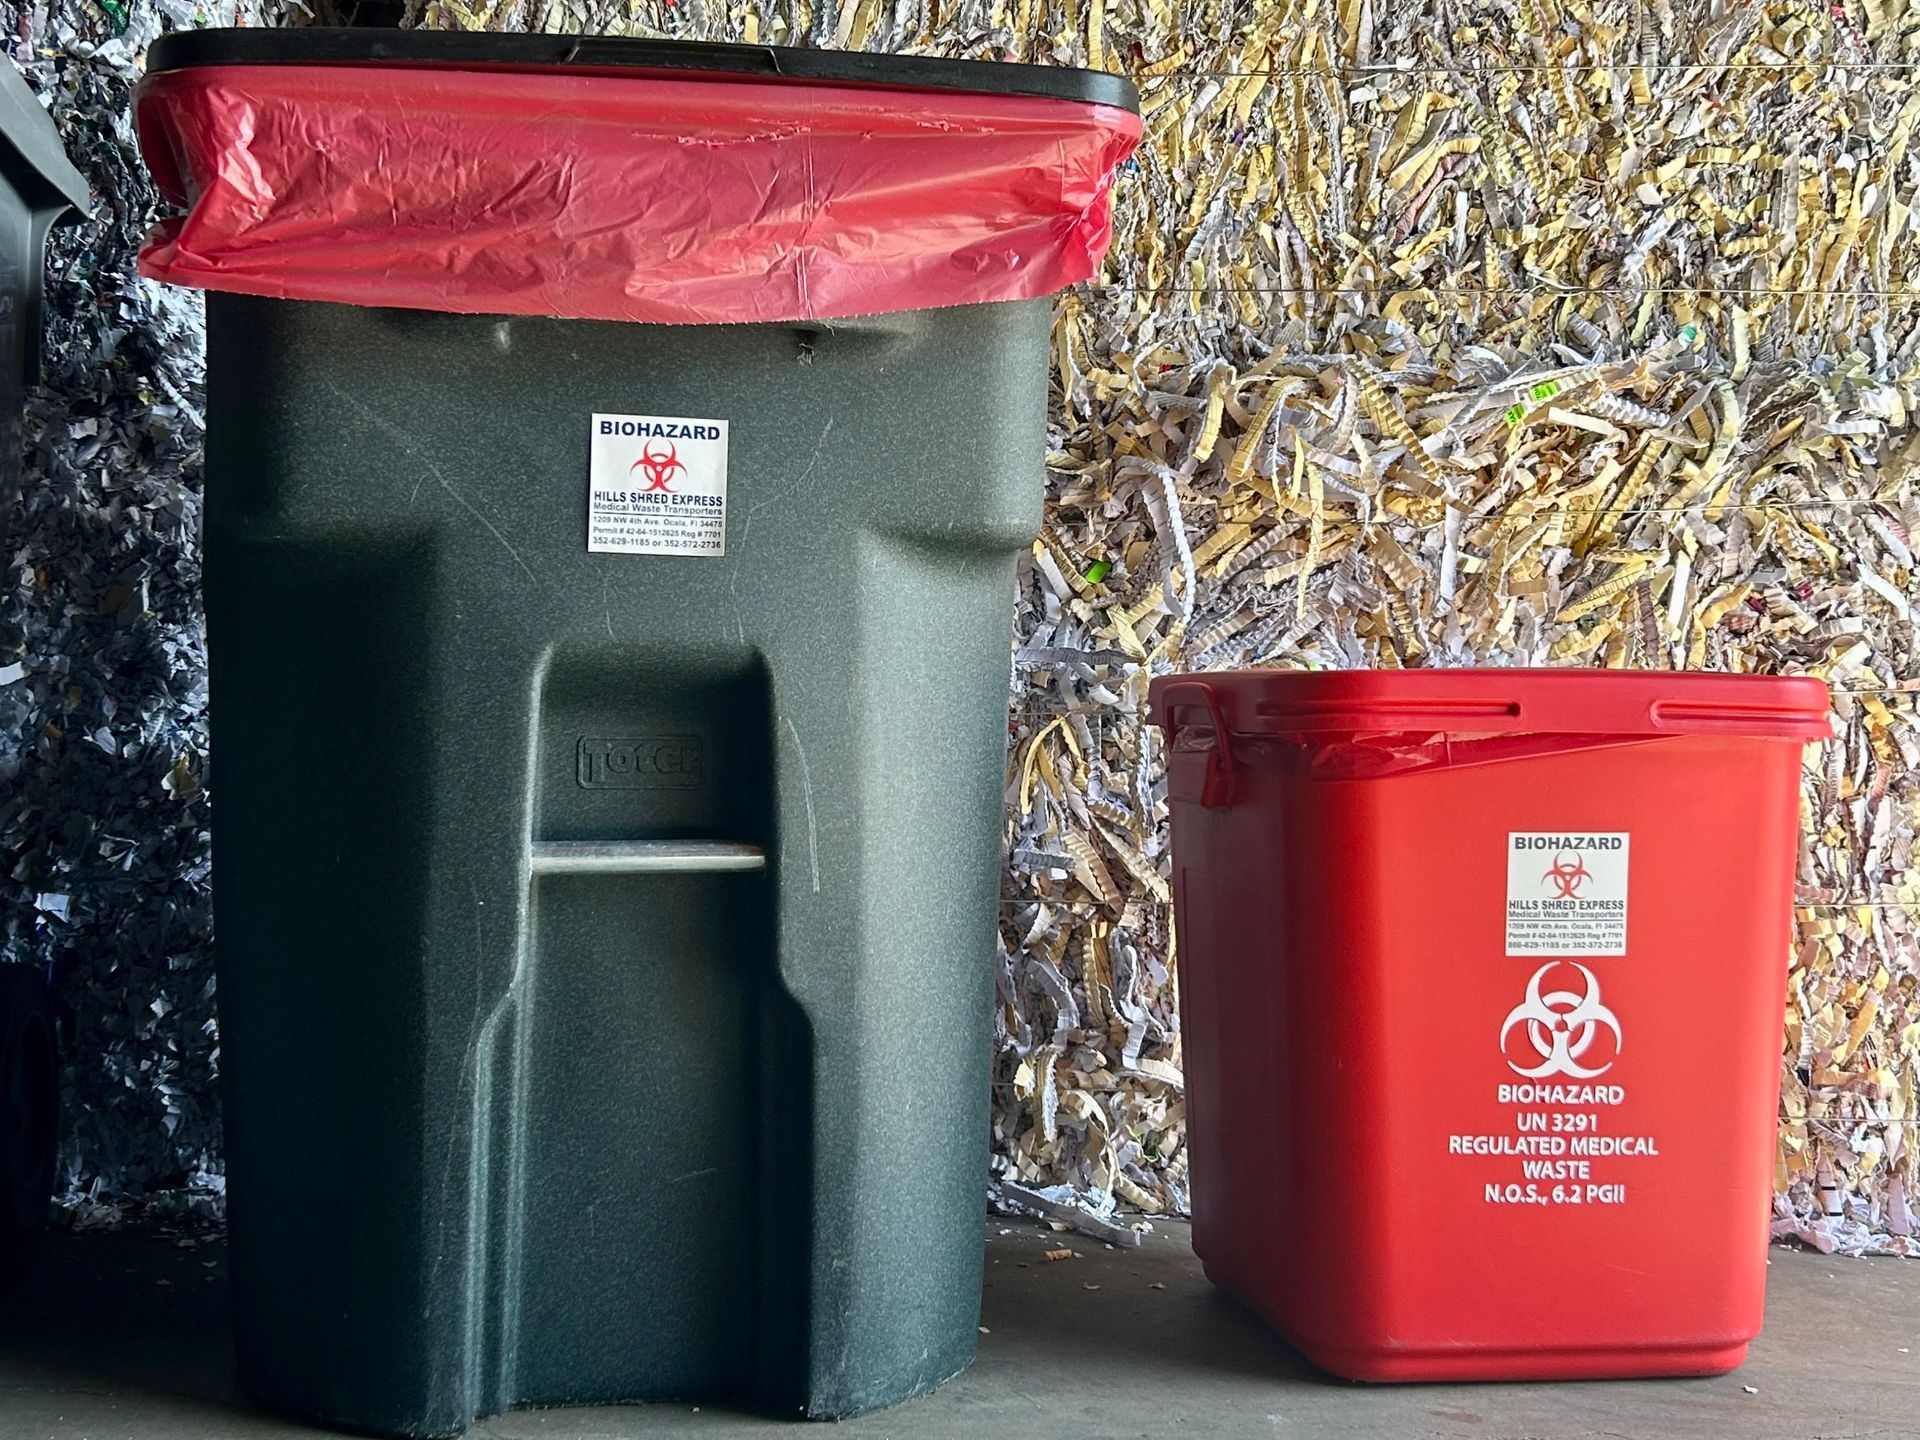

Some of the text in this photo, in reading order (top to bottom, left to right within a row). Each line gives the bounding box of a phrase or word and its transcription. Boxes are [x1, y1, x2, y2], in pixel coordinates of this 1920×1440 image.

[601, 421, 720, 440] BIOHAZARD
[595, 491, 722, 506] HILLS SHRED EXPRESS
[594, 503, 722, 516] Medical Waste Transporters
[664, 519, 688, 527] Ocala,
[594, 526, 618, 534] Permit
[681, 531, 696, 539] Reg
[593, 537, 649, 546] 352-629-1185
[665, 540, 721, 549] 352-572-2736
[1515, 837, 1622, 850] BIOHAZARD
[1509, 901, 1624, 910] HILLS SHRED EXPRESS
[1573, 911, 1624, 919] Transporters
[1498, 1085, 1624, 1105] BIOHAZARD
[1517, 1113, 1597, 1132] UN 3291
[1449, 1136, 1659, 1155] REGULATED MEDICAL
[1522, 1161, 1590, 1179] WASTE
[1484, 1184, 1547, 1206] N.O.S.,
[1552, 1185, 1582, 1204] 6.2
